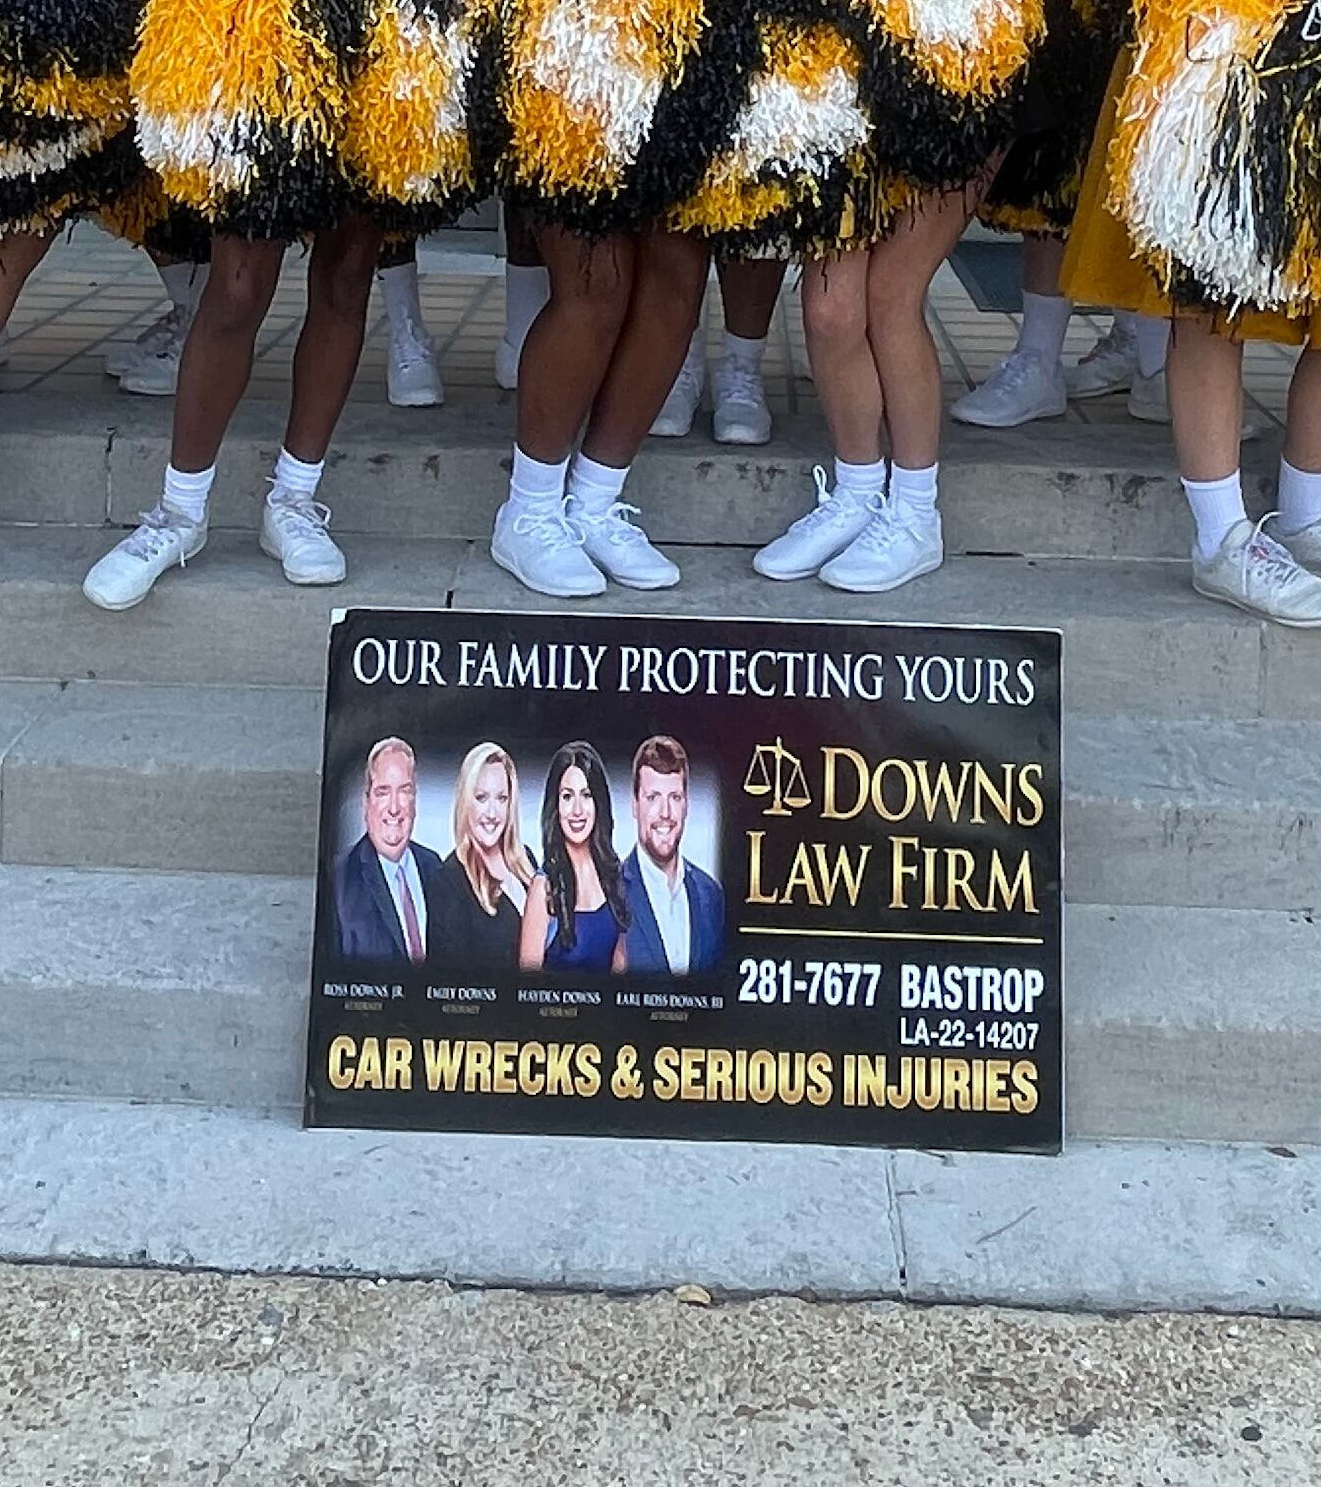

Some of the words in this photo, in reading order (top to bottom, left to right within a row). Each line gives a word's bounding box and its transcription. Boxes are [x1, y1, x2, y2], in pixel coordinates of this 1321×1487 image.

[352, 637, 446, 687] OUR
[457, 641, 608, 691] FAMILY
[617, 646, 885, 701] PROTECTING
[893, 655, 1036, 707] YOURS
[819, 746, 1045, 827] DOWNS
[744, 830, 870, 907] LAW
[887, 835, 1040, 914] FIRM
[737, 958, 882, 1008] 281-7677
[900, 963, 1045, 1013] BASTROP
[900, 1015, 1040, 1052] LA-22-14207
[327, 1034, 413, 1092] CAR
[422, 1038, 602, 1099] WRECKS
[610, 1044, 645, 1100] &
[651, 1046, 834, 1107] SERIOUS
[843, 1053, 1039, 1114] INJURIES
